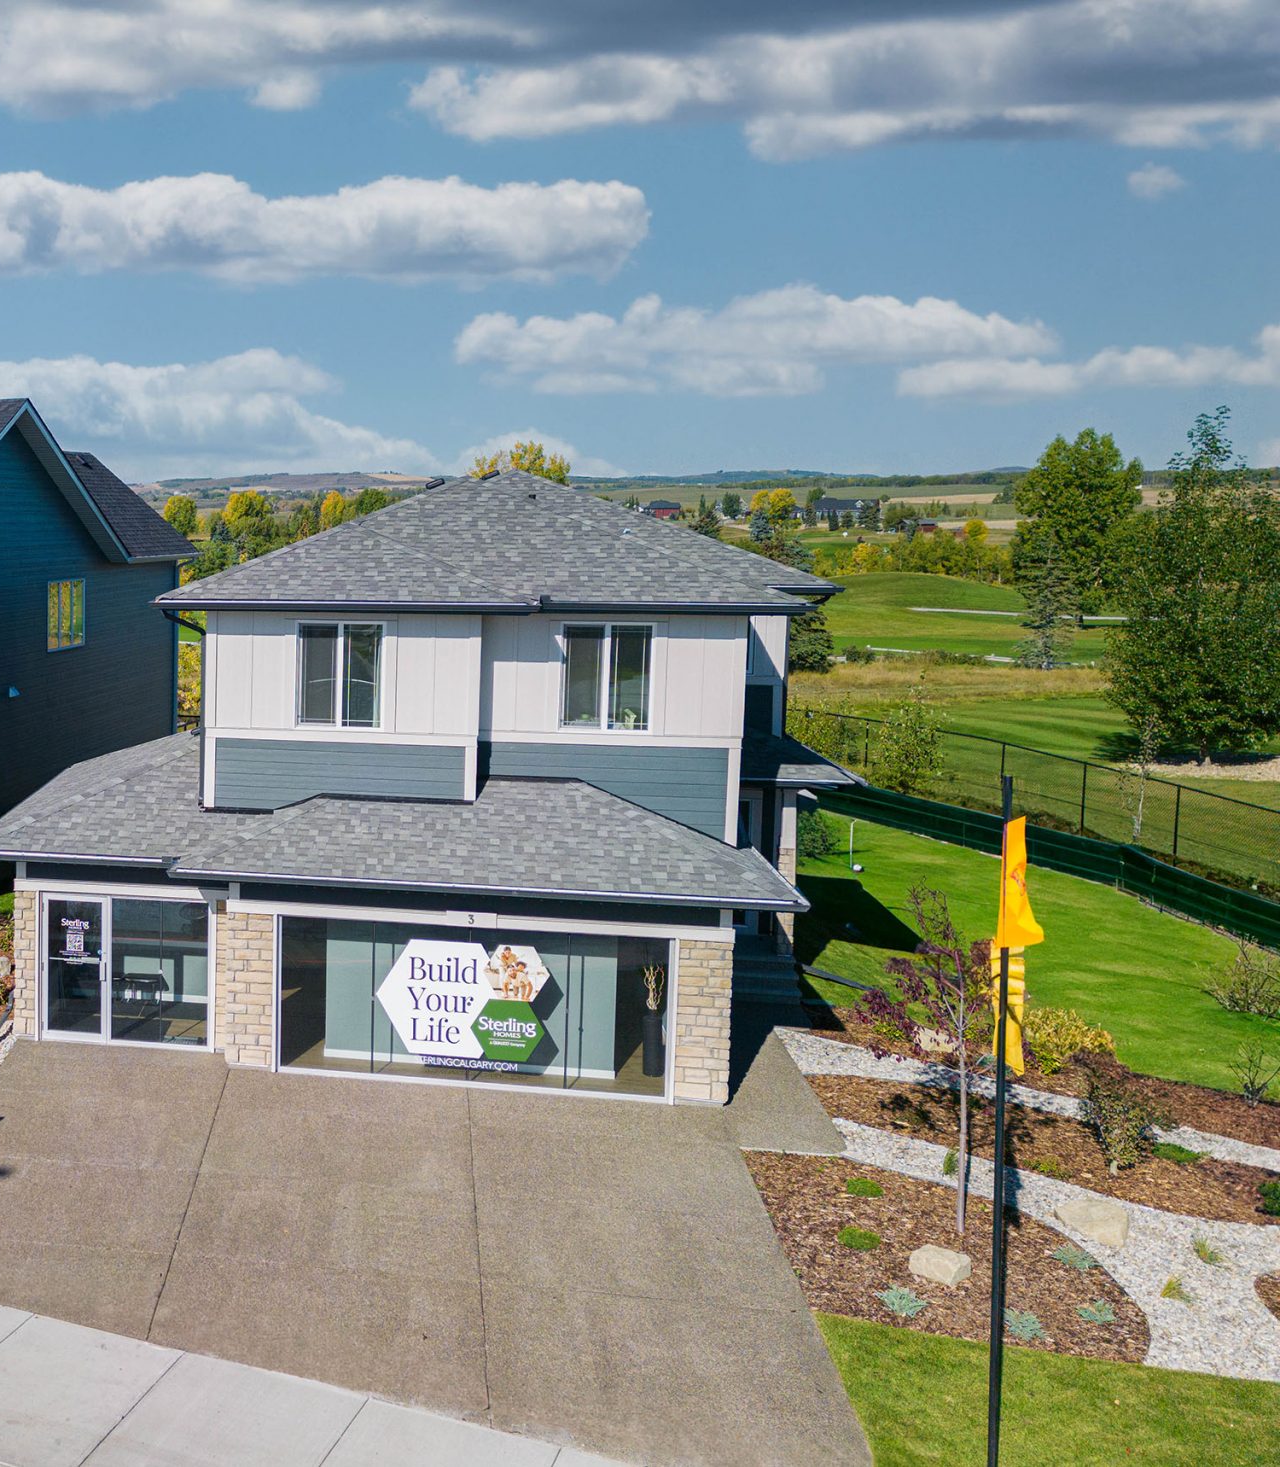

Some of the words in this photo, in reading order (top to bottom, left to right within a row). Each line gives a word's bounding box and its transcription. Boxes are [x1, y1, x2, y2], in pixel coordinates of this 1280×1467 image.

[61, 917, 90, 930] Sterling
[467, 914, 475, 925] 3
[408, 956, 479, 985] Build
[407, 986, 474, 1014] Your
[410, 1017, 461, 1045] Life
[477, 1016, 537, 1038] Sterling
[493, 1031, 522, 1039] HOMES
